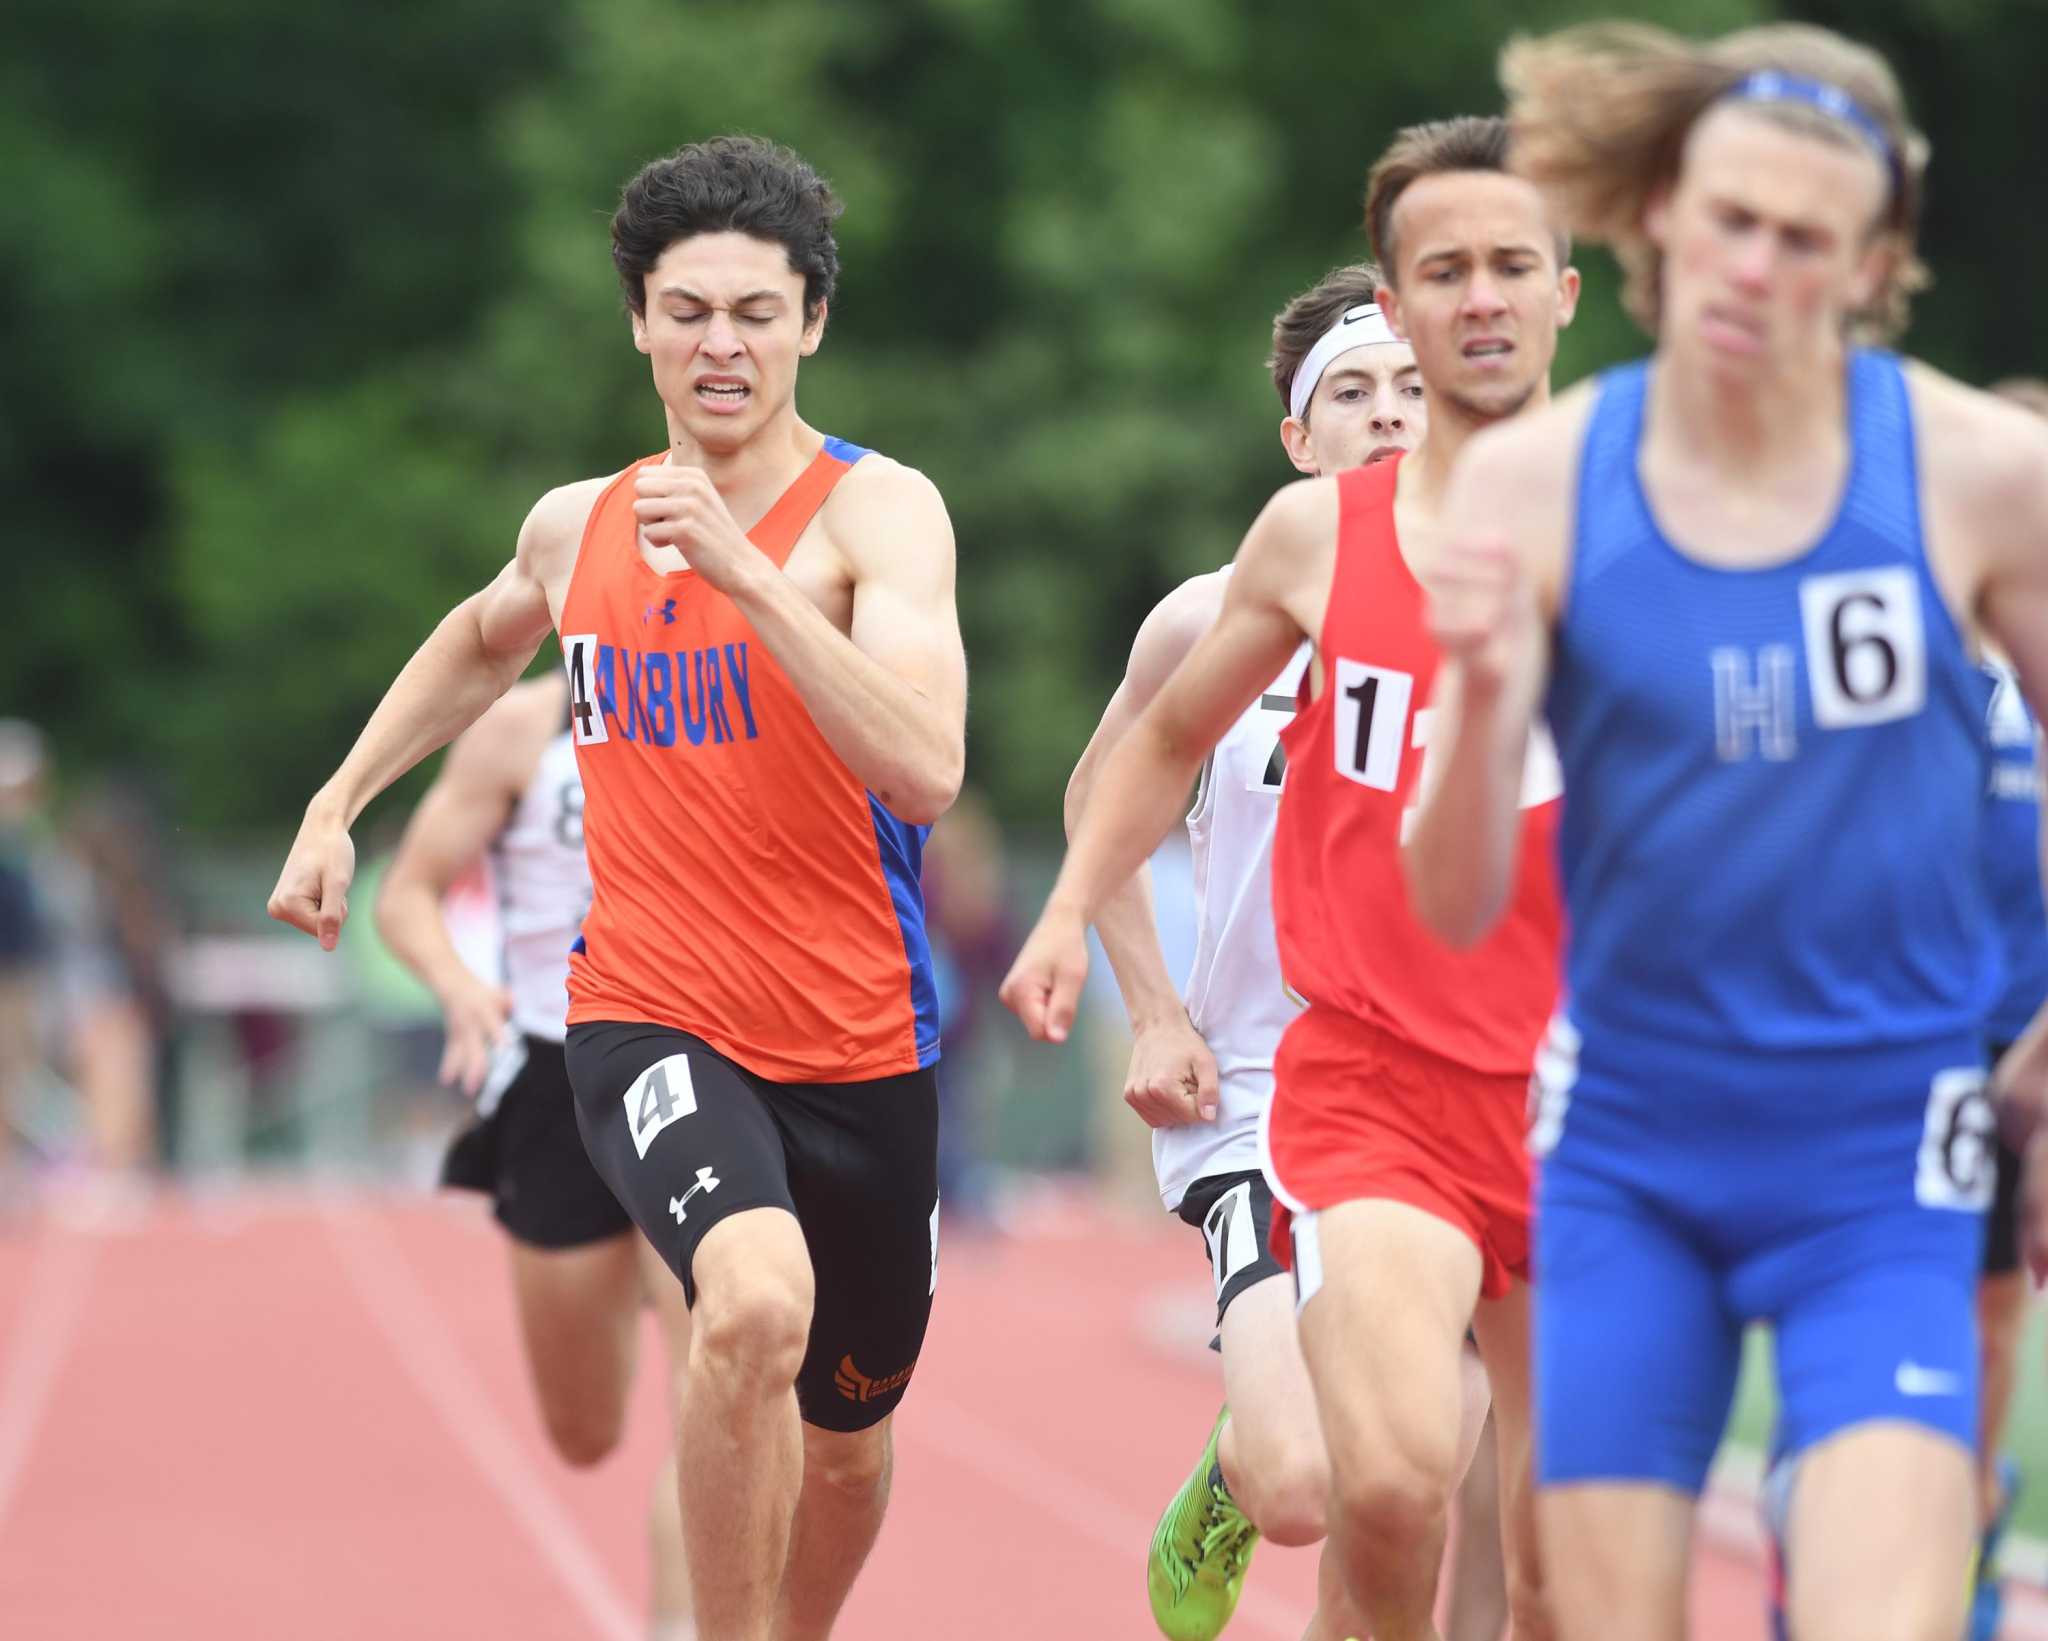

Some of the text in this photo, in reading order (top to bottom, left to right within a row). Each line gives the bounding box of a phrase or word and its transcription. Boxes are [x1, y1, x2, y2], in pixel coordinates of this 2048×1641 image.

[571, 642, 593, 737] 4
[1830, 593, 1897, 705] 6
[1346, 676, 1379, 774] 1
[1712, 647, 1797, 762] H
[637, 1065, 681, 1136] 4
